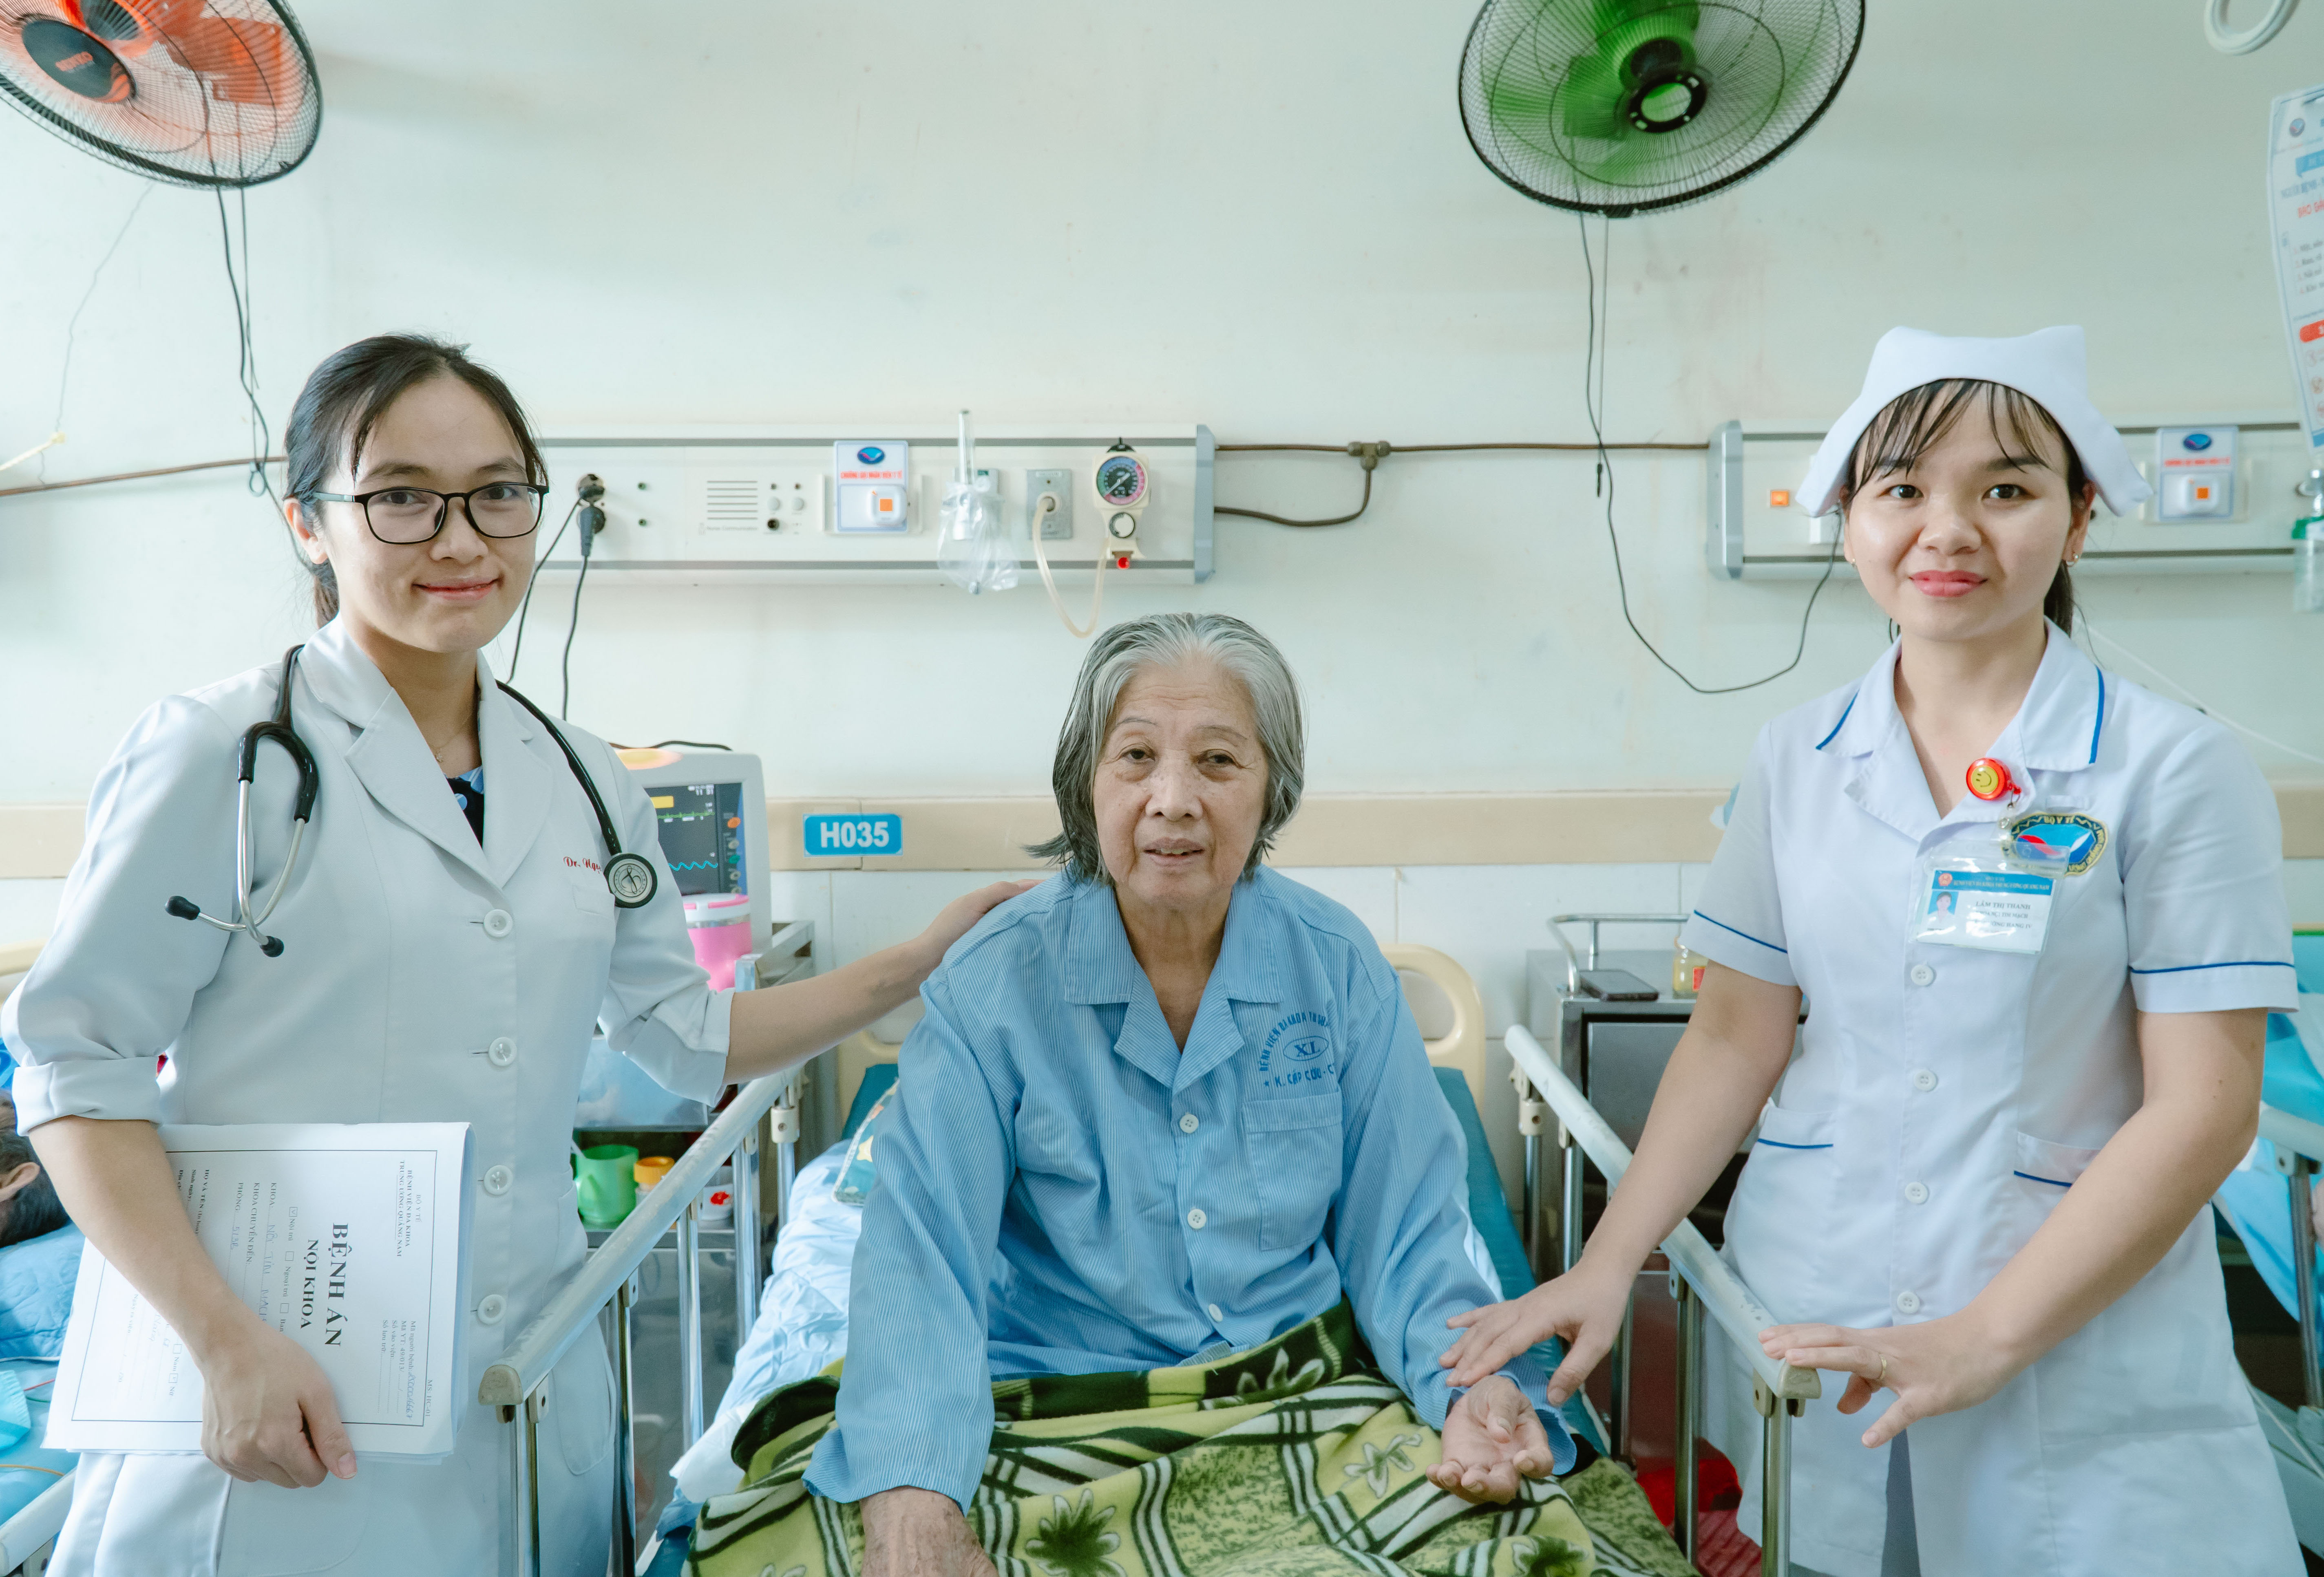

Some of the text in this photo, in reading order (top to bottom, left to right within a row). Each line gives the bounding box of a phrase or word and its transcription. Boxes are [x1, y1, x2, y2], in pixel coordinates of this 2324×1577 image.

[820, 821, 889, 848] H035
[1295, 1041, 1321, 1057] XL
[204, 1169, 210, 1180] HỌ
[202, 1182, 209, 1191] VÀ
[235, 1182, 244, 1213] PHÒNG:
[252, 1182, 260, 1206] KHOA
[415, 1195, 422, 1204] BỘ
[415, 1213, 422, 1223] TẾ
[248, 1208, 258, 1243] CHUYỂN
[300, 1239, 319, 1329] NỘI KHOA
[324, 1223, 352, 1347] BỆNH ÁN
[130, 1294, 139, 1310] Ngày
[382, 1320, 388, 1328] Số
[392, 1320, 398, 1328] Số
[401, 1321, 406, 1331] Mã
[411, 1321, 416, 1331] Mã
[169, 1387, 175, 1396] Nữ
